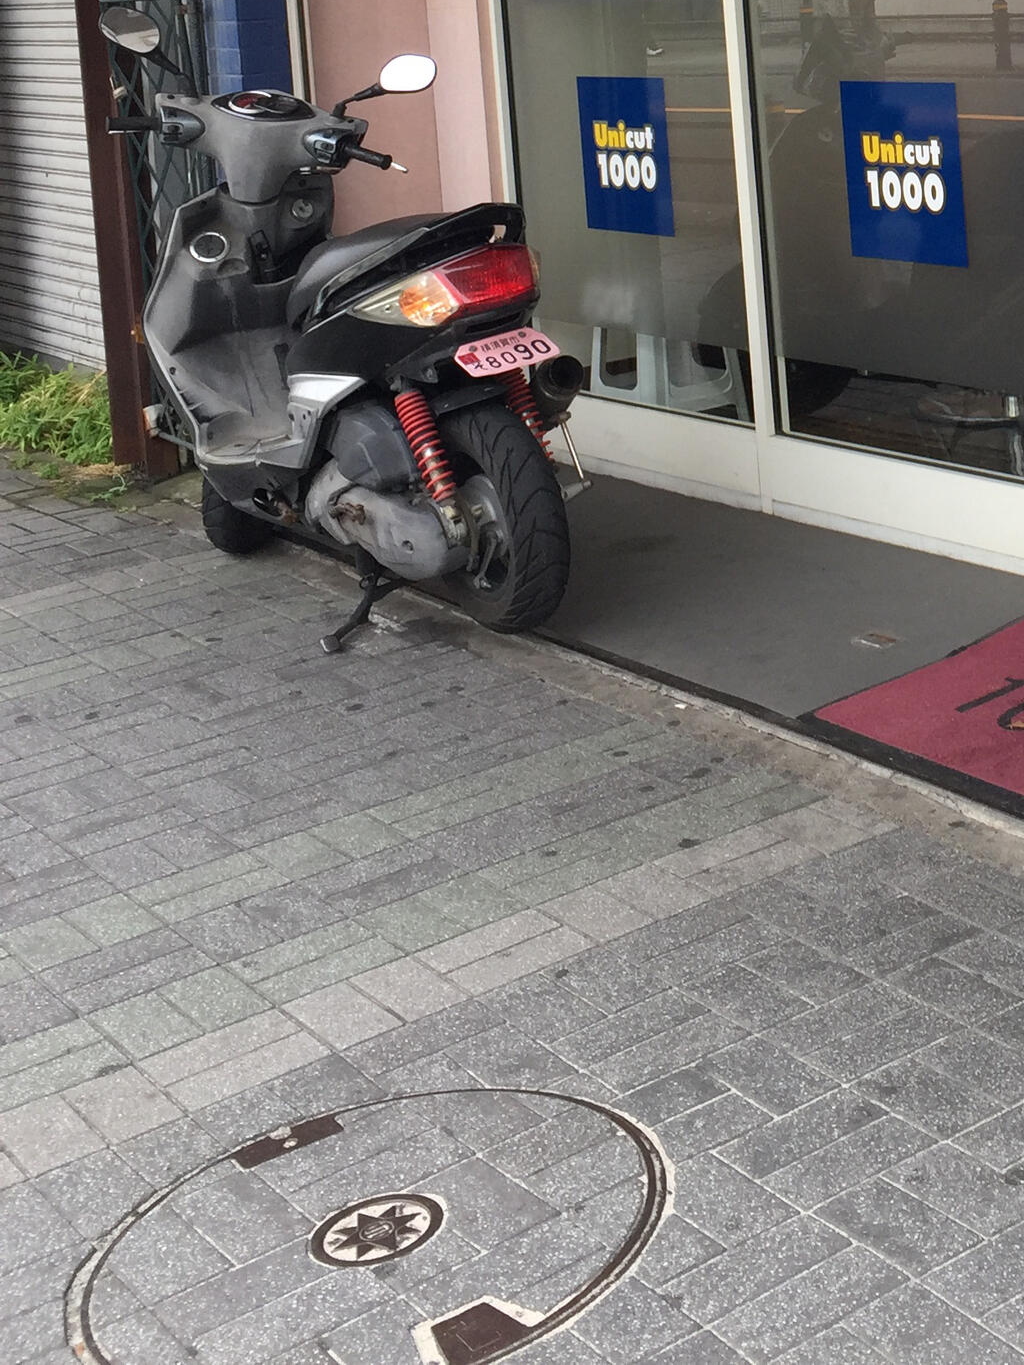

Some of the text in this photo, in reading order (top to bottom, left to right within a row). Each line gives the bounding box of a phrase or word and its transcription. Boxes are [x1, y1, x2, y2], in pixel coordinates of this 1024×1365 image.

[592, 120, 655, 151] Unicut
[861, 131, 943, 168] Unicut
[596, 151, 658, 192] 1000
[865, 167, 946, 215] 1000
[485, 339, 551, 369] 8090
